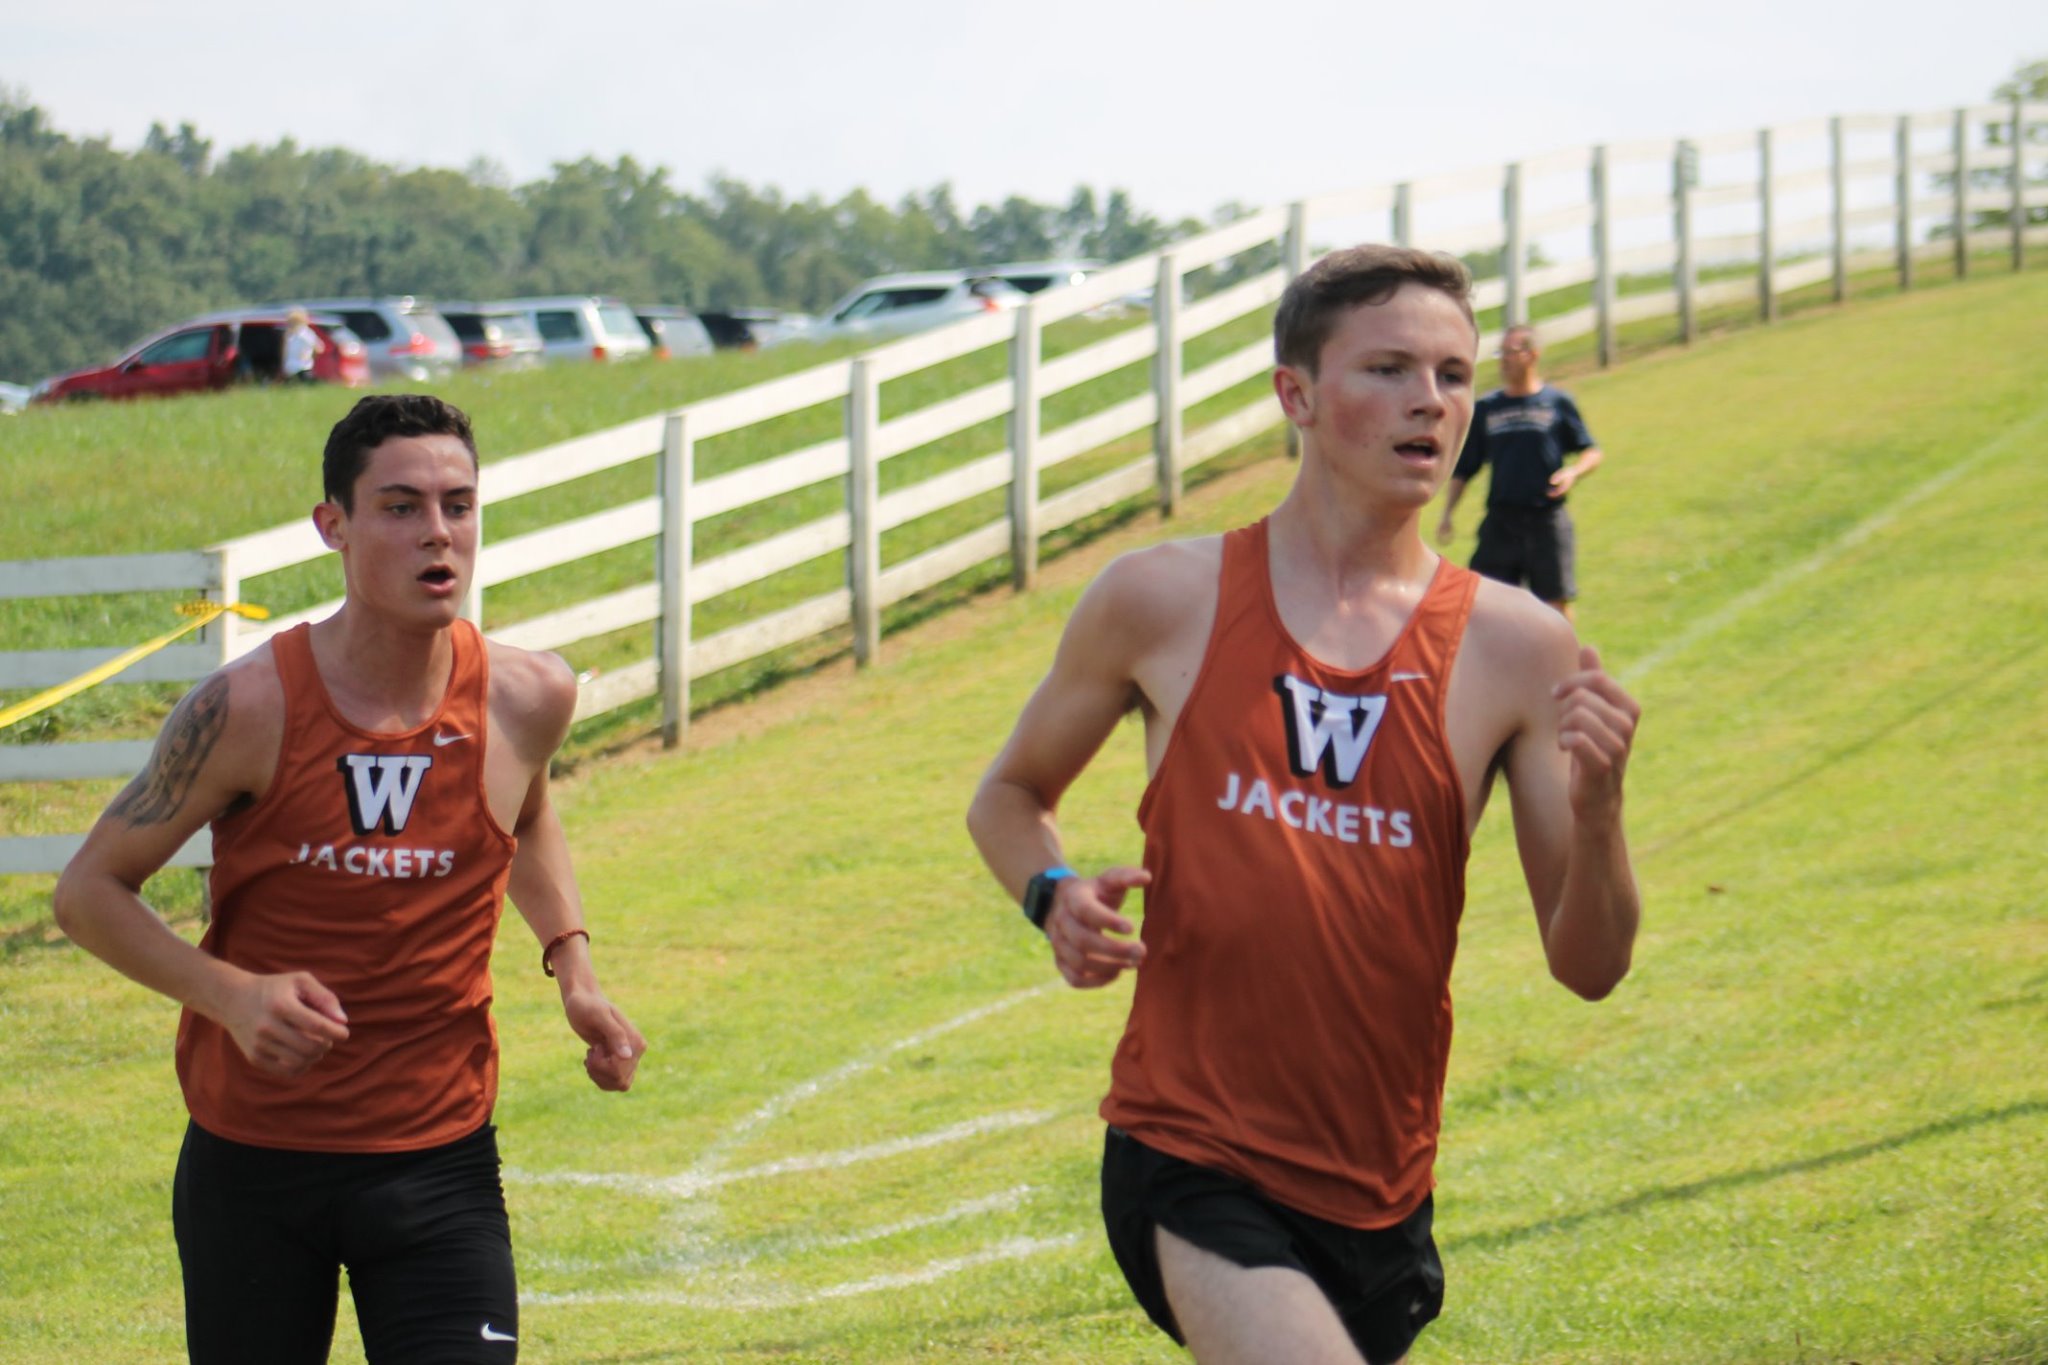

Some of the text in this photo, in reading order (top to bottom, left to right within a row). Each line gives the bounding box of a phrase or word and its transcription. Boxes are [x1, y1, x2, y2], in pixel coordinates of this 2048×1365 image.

[1273, 673, 1388, 790] W
[337, 754, 433, 837] W
[1217, 772, 1413, 848] JACKETS
[289, 842, 455, 878] JACKETS
